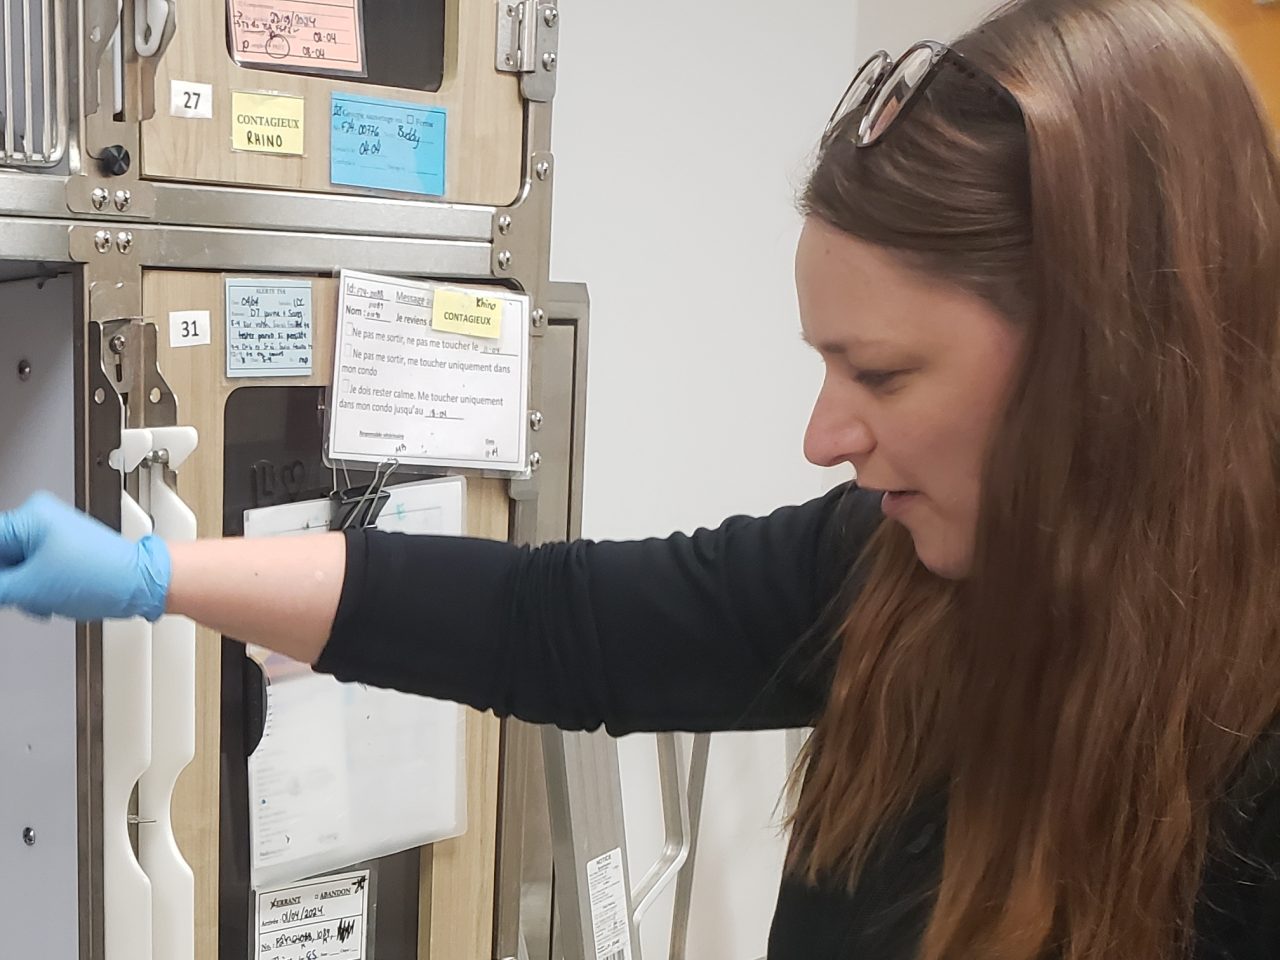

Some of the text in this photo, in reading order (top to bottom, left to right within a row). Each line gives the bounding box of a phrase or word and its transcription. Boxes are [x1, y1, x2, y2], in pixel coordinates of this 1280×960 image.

[183, 91, 201, 110] 27
[237, 114, 300, 129] CONTAGIEUX
[246, 130, 283, 147] RHINO
[396, 291, 425, 306] Message
[346, 305, 362, 316] Nom
[396, 313, 402, 323] Je
[404, 315, 427, 326] reviens
[444, 311, 491, 326] CONTAGIEUX
[181, 320, 199, 337] 31
[352, 327, 362, 338] Ne
[363, 330, 374, 340] pas
[375, 332, 385, 340] me
[406, 337, 415, 345] ne
[416, 338, 428, 348] pas
[442, 340, 470, 351] toucher
[472, 341, 479, 351] le
[353, 348, 362, 359] Ne
[363, 352, 375, 361] pas
[376, 354, 385, 362] me
[407, 358, 418, 366] me
[420, 357, 447, 369] toucher
[448, 361, 492, 373] uniquement
[494, 363, 511, 374] dans
[341, 365, 377, 377] mon condo
[349, 384, 503, 407] Je dois rester calme. Me toucher uniquement
[339, 399, 354, 409] dans
[356, 402, 370, 411] mon
[372, 403, 392, 413] condo
[320, 888, 351, 899] ABANDON
